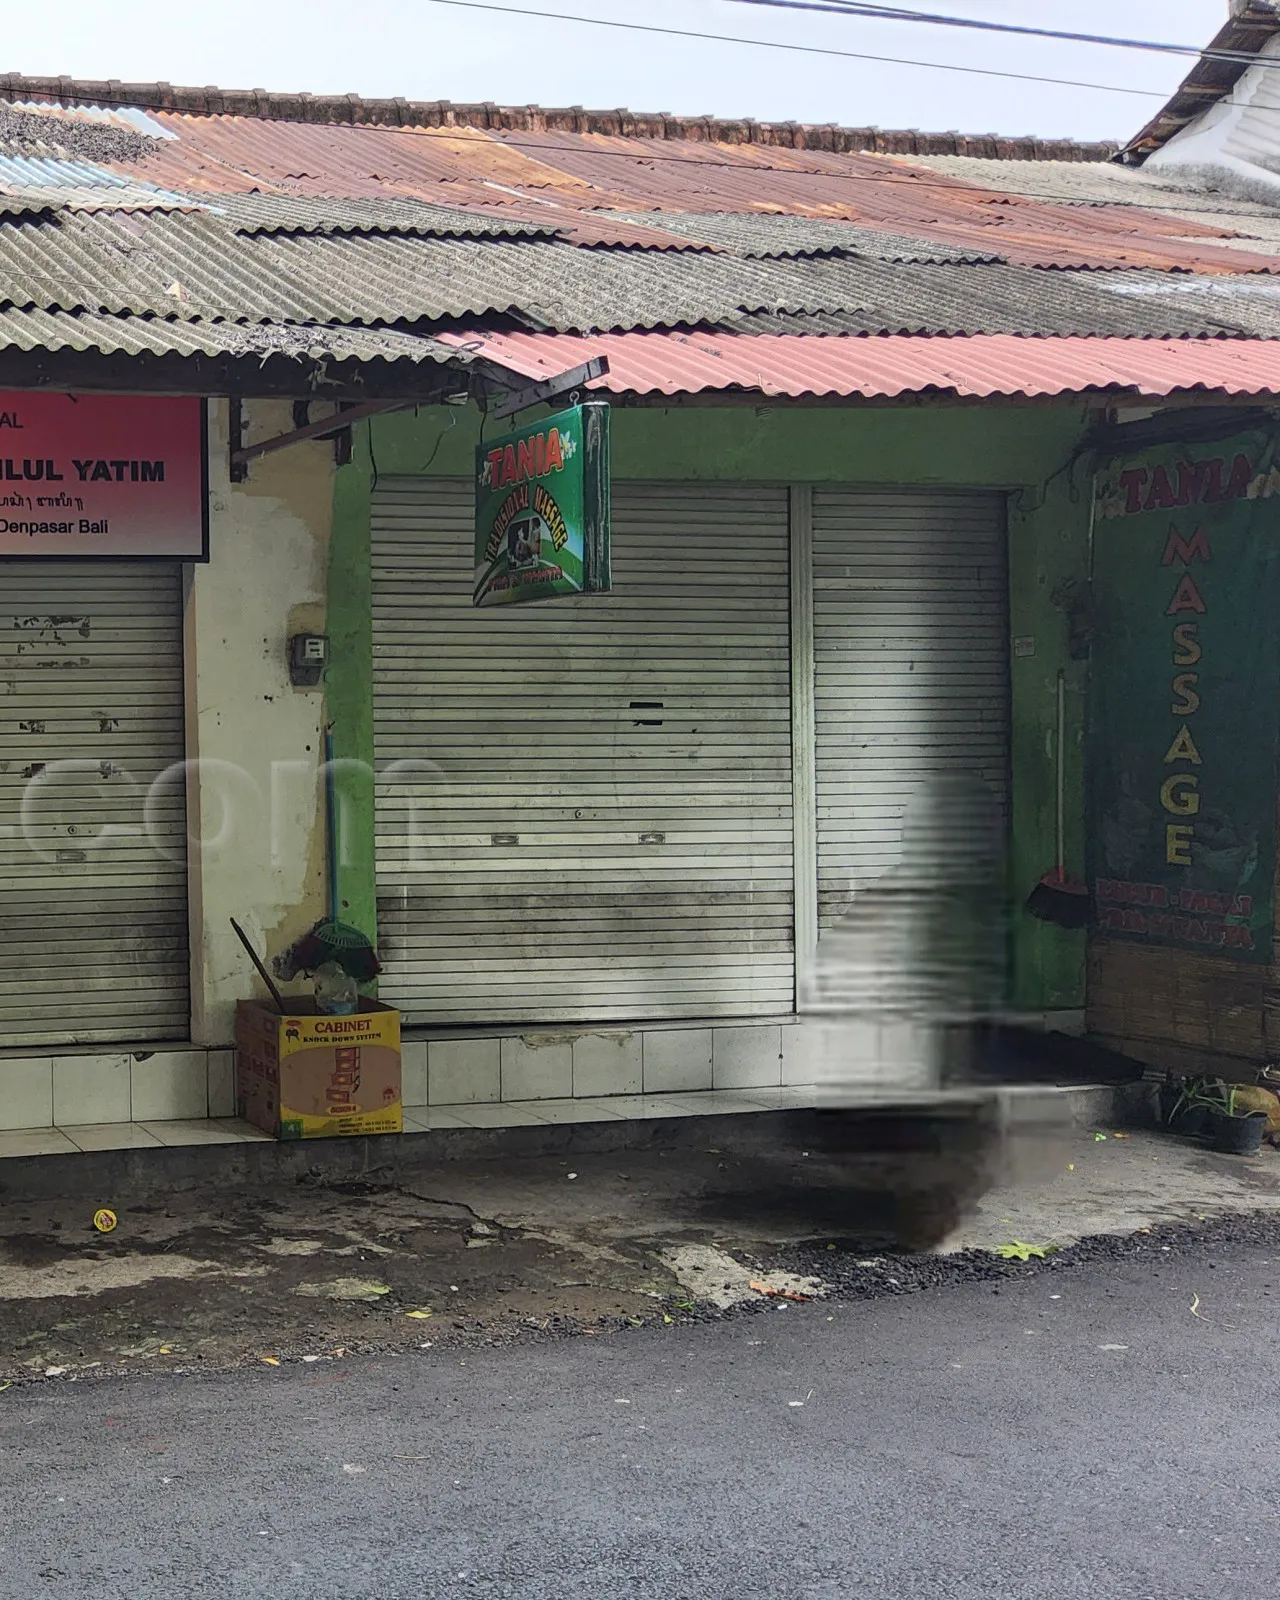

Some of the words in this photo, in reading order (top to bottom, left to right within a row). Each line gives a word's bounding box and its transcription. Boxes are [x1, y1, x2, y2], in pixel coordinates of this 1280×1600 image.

[72, 459, 166, 483] YATIM
[487, 427, 564, 492] TANIA
[1119, 454, 1254, 513] TANIA
[80, 519, 109, 534] Bali
[533, 484, 569, 552] MASSAGE
[1160, 521, 1212, 867] MASSAGE
[314, 1019, 373, 1034] CABINET
[332, 1035, 355, 1043] DOWN
[356, 1032, 382, 1041] SYSTEM
